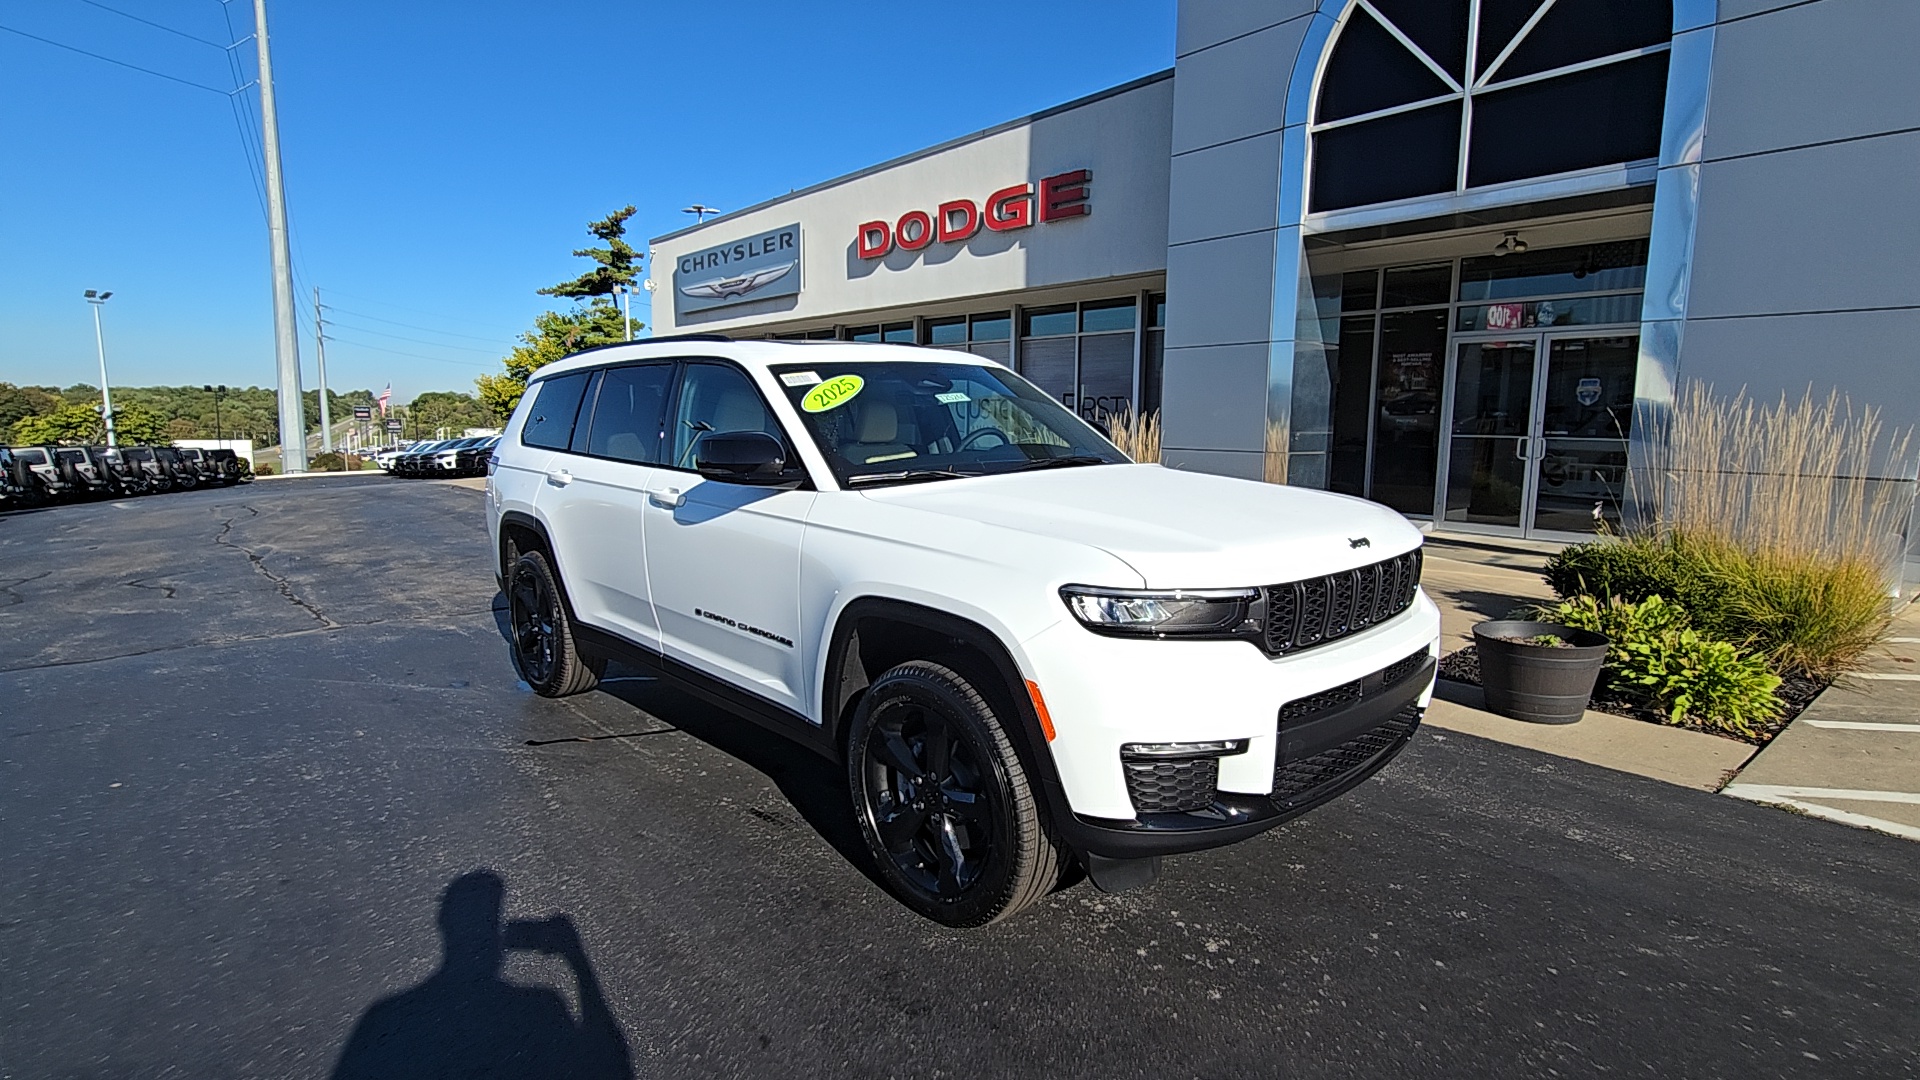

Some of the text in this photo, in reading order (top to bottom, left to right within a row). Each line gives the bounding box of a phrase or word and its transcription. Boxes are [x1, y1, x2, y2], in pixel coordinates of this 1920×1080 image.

[857, 169, 1091, 259] DODGE
[681, 232, 794, 274] CHRYSLER
[813, 379, 856, 407] 2025
[1062, 392, 1124, 420] FRST
[703, 611, 736, 627] GRAND
[738, 623, 794, 648] CHEROKEE
